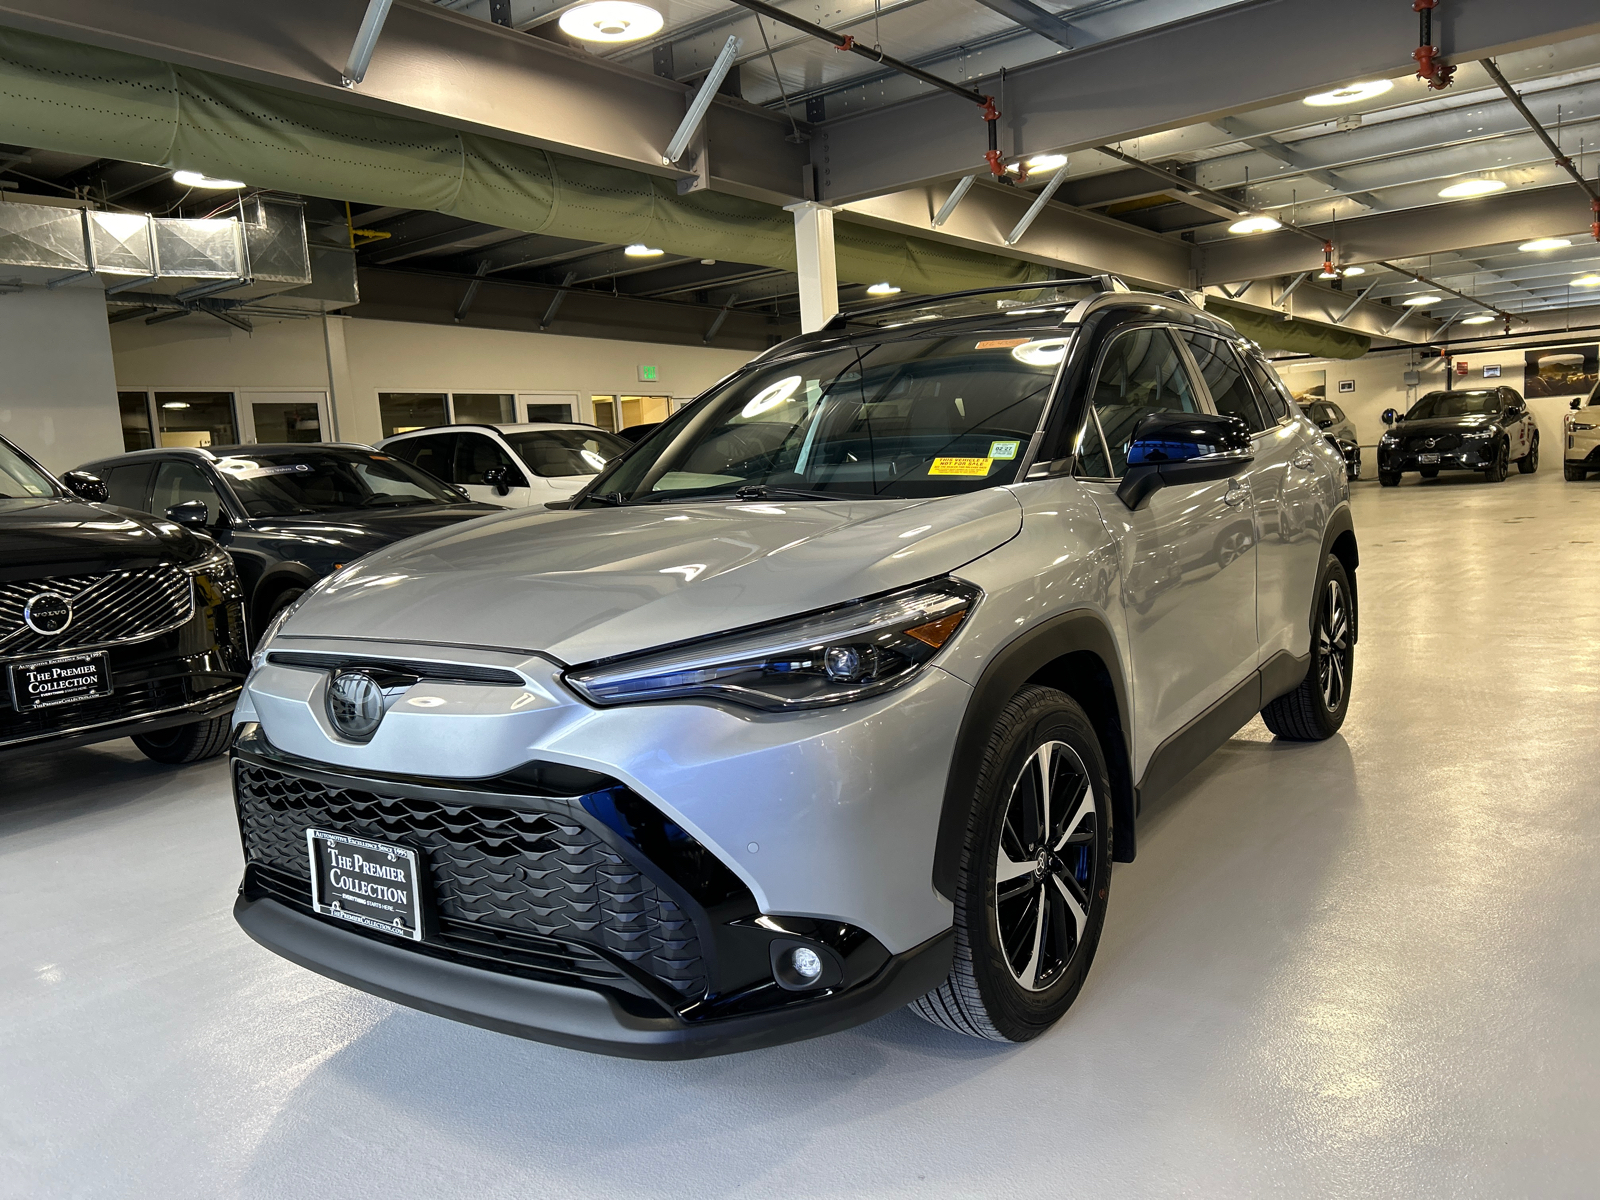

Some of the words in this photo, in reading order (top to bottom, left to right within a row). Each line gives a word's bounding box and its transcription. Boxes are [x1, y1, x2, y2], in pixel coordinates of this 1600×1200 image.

[644, 366, 656, 379] EXIT
[32, 610, 67, 618] VOLVO
[26, 671, 52, 682] THE
[52, 664, 97, 678] PREMIER
[28, 675, 98, 694] COLLECTION
[315, 831, 347, 843] AUTOMOTIVE
[348, 837, 377, 849] EXCELLENCE
[378, 844, 393, 853] SINCE
[393, 847, 408, 857] 1995
[327, 848, 353, 871] THE
[353, 854, 406, 883] PREMIER
[330, 868, 407, 905] COLLECTION
[342, 893, 366, 905] EVERYTHING
[367, 900, 382, 909] STARTS
